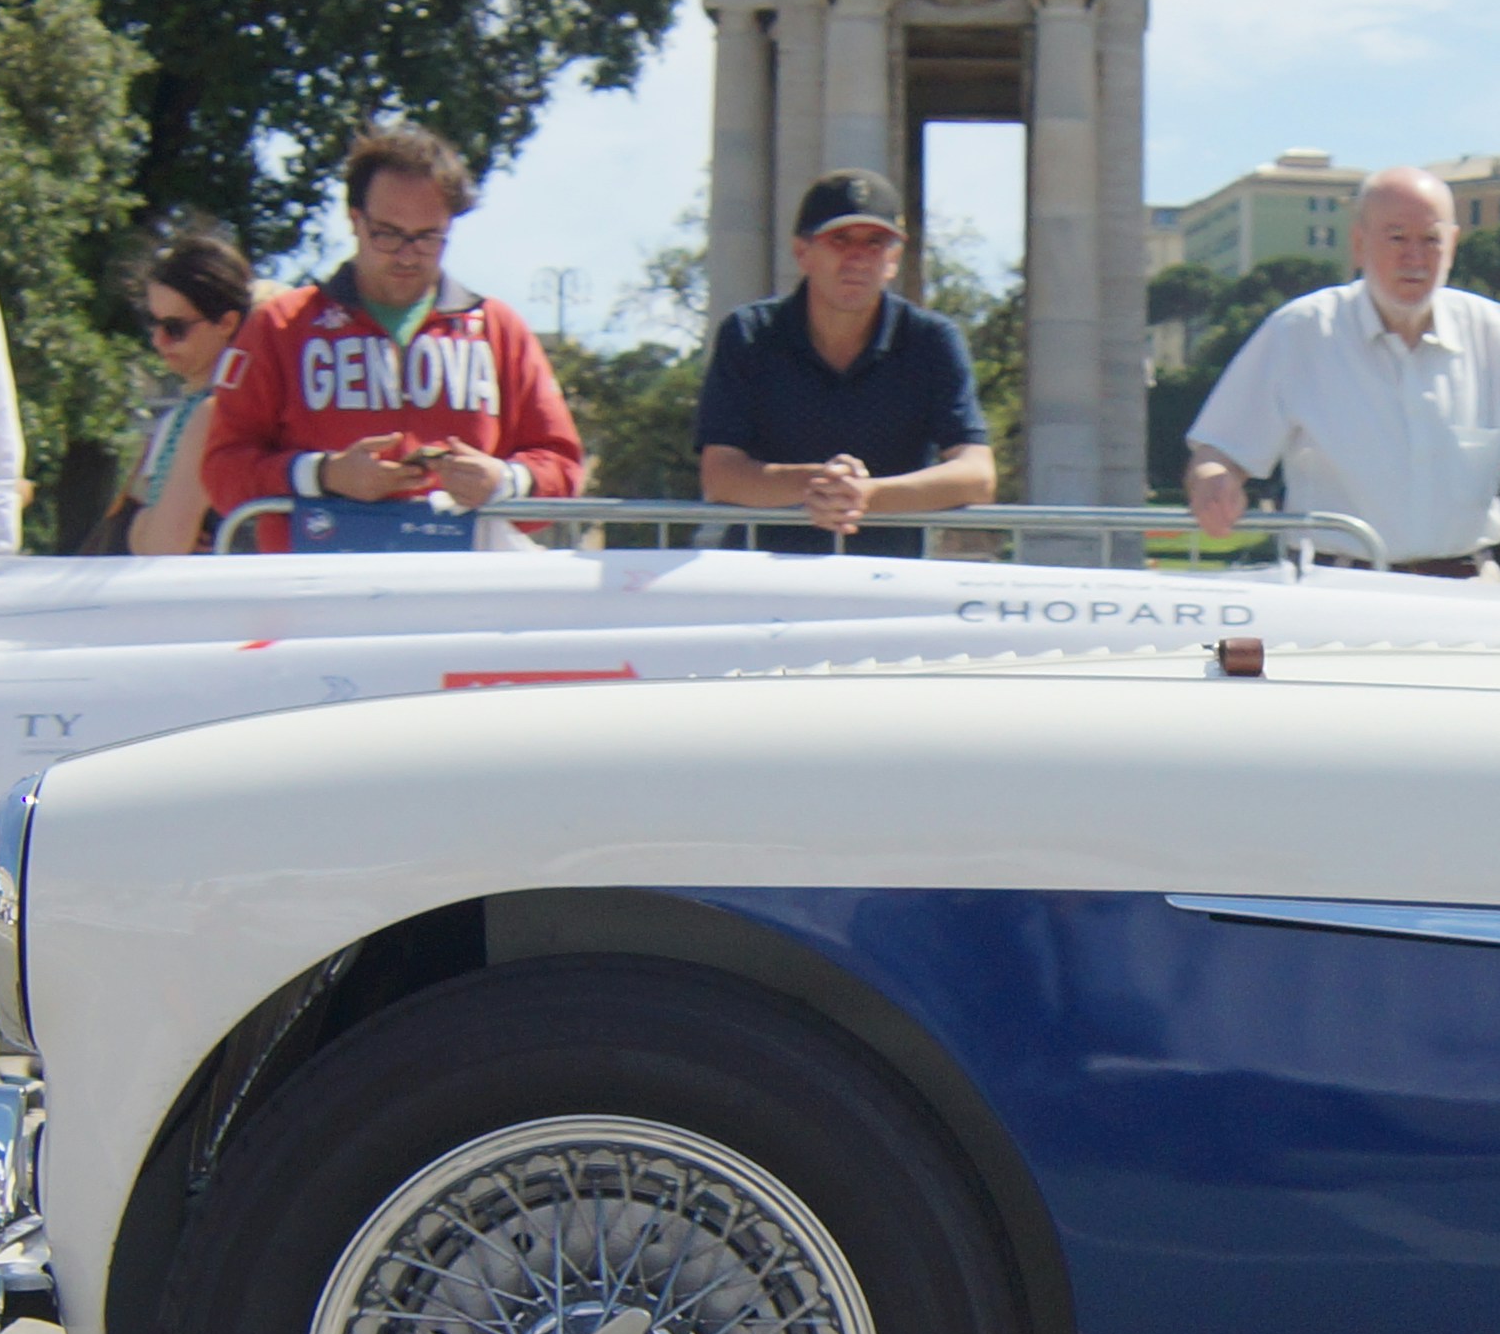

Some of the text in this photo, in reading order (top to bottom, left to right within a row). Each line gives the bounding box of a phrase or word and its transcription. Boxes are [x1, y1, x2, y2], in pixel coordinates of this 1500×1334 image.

[302, 333, 501, 416] GENOVA
[956, 599, 1254, 627] CHOPARD
[15, 713, 83, 738] TY
